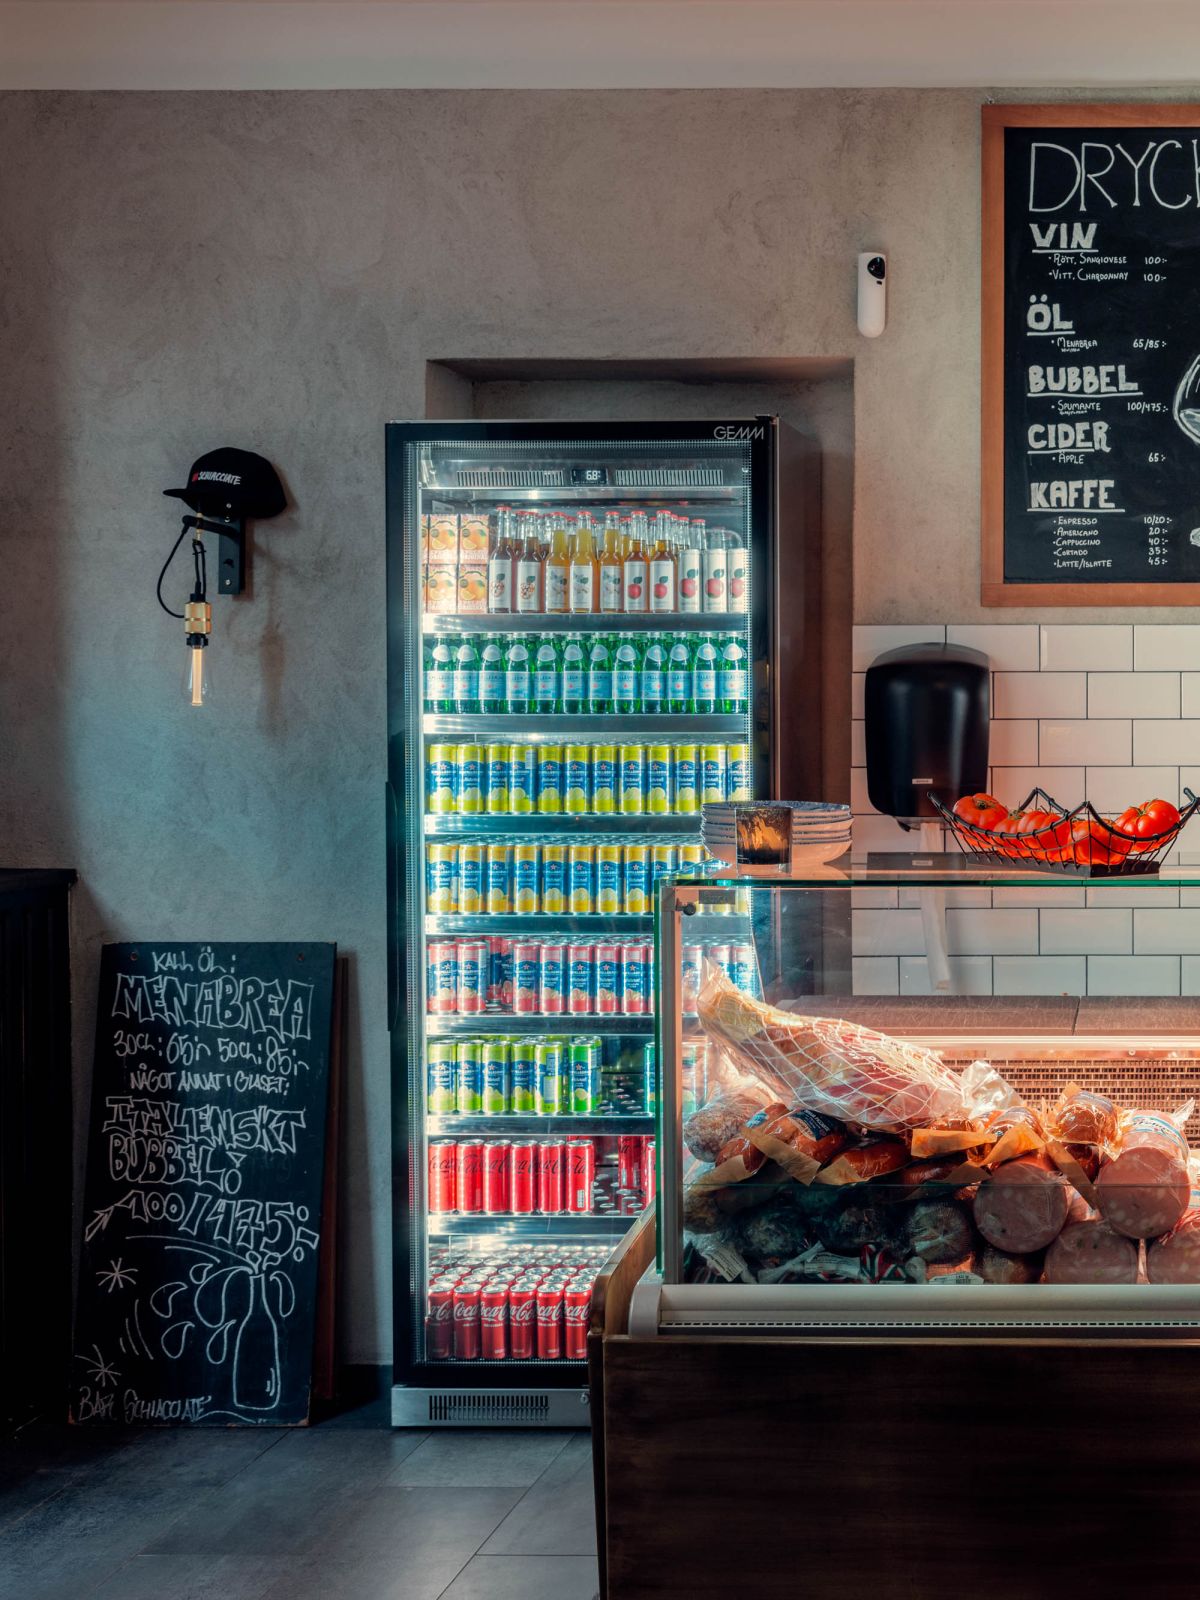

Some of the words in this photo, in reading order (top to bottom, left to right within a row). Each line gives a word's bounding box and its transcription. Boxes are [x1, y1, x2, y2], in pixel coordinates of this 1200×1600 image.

[1029, 223, 1098, 249] VIN
[1027, 294, 1073, 331] ÖL
[1028, 364, 1139, 393] BUBBEL
[1027, 421, 1112, 452] CIDER
[1030, 479, 1115, 509] KAFFE
[112, 973, 314, 1043] MENABREA
